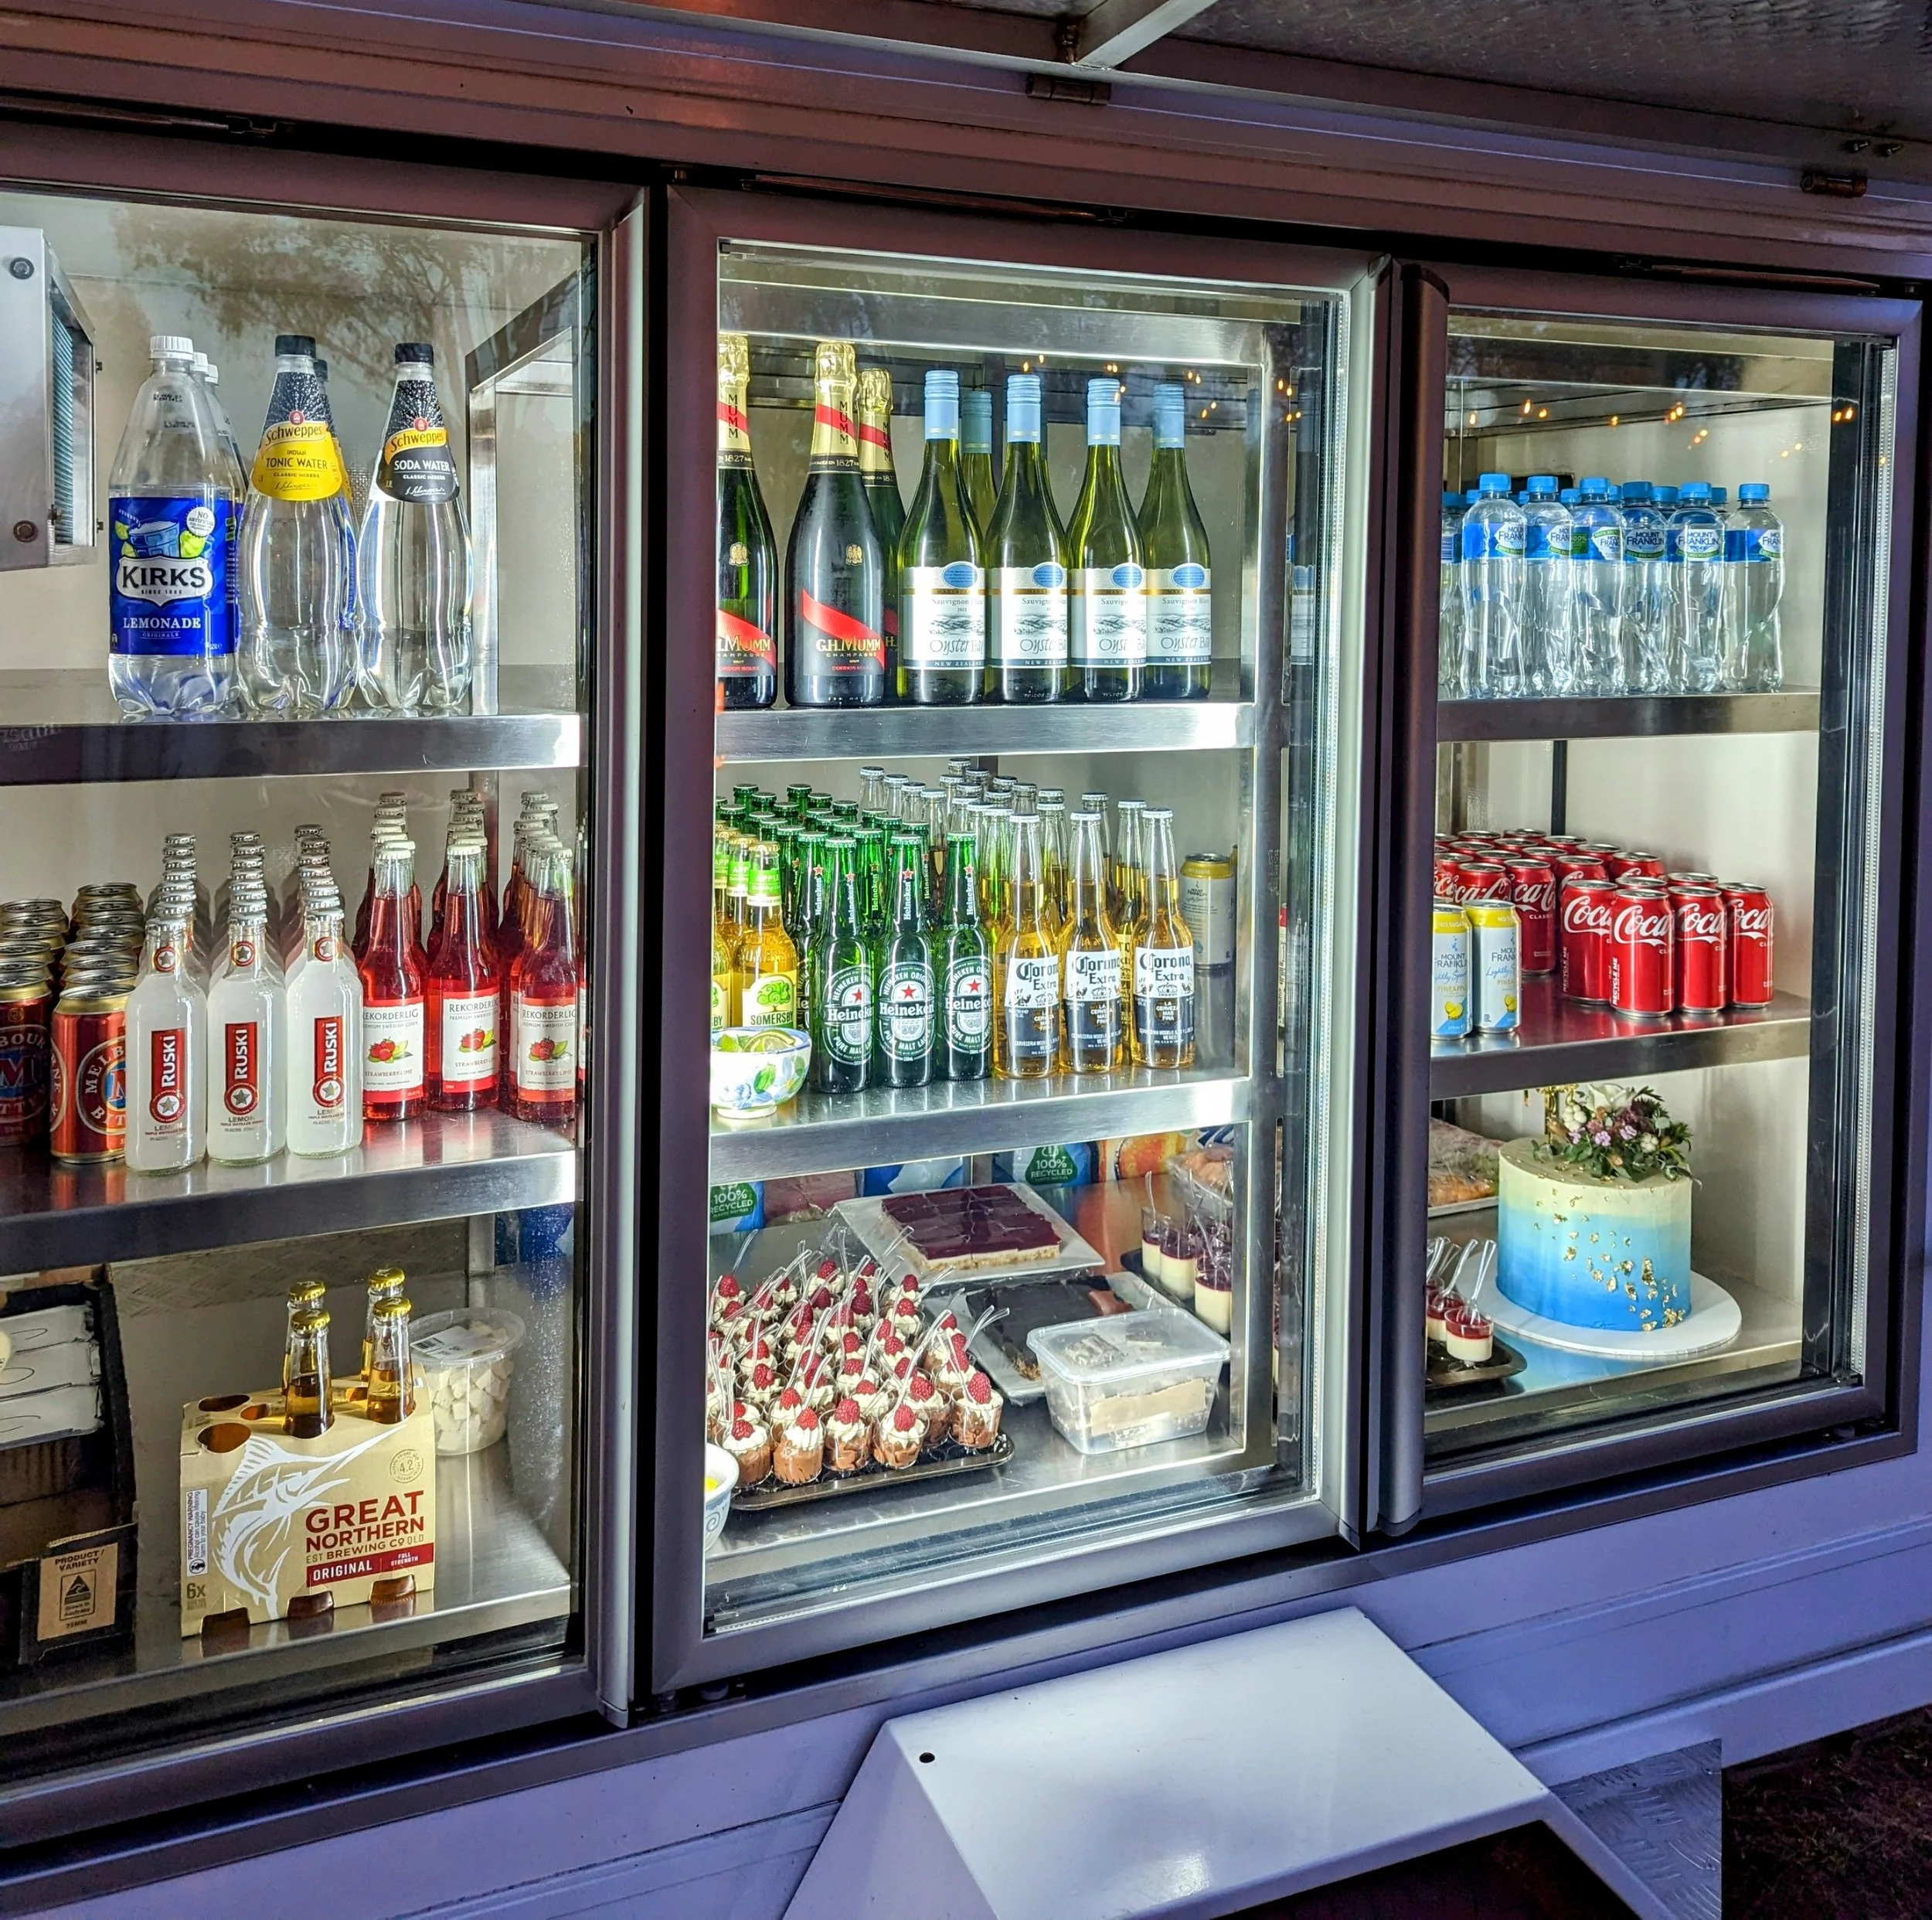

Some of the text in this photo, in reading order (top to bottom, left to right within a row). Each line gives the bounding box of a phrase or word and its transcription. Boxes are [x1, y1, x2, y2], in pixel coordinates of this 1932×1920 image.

[265, 426, 322, 446] Schweppes
[390, 432, 444, 452] Schweppes
[266, 458, 328, 469] TONIC WATER
[394, 460, 451, 471] SODA WATER
[1498, 532, 1524, 540] FRANK
[1550, 533, 1570, 541] FRAN
[1627, 537, 1665, 546] FRANKLIN
[1679, 536, 1719, 545] FRANKLIN
[1763, 536, 1781, 545] FRAN
[122, 566, 206, 588] KIRKS
[1162, 597, 1198, 606] Sauvignon
[123, 618, 201, 629] LEMONADE
[718, 635, 770, 651] .MUMM
[930, 638, 969, 655] Oyster
[1020, 638, 1053, 655] Oyst
[1099, 638, 1127, 654] Oyst
[1161, 637, 1198, 652] Oyster
[903, 880, 912, 921] Heineken
[1139, 952, 1192, 972] Corona
[1613, 957, 1618, 972] ME
[1016, 962, 1059, 982] Coron
[1089, 972, 1116, 984] Extra
[1155, 970, 1184, 981] Extra
[1486, 967, 1509, 979] Lightly
[832, 975, 859, 1000] HEINEKEN
[1033, 979, 1057, 991] Extra
[879, 1002, 934, 1016] Heineken
[945, 997, 992, 1011] Heineke
[750, 1011, 794, 1026] SOMERSBY
[827, 1006, 872, 1021] Heineke
[951, 1024, 981, 1043] PURE MALT
[324, 1022, 338, 1074] RUSKI
[833, 1036, 847, 1051] PURE
[899, 1041, 916, 1050] MALT
[161, 1035, 176, 1088] RUSKI
[234, 1029, 248, 1080] RUSKI
[365, 1069, 413, 1077] STRAWBERRY-LIME
[1036, 1159, 1067, 1169] 100%
[1031, 1168, 1073, 1180] RECYCLED
[713, 1189, 747, 1205] 100%
[711, 1199, 753, 1214] RECYCLED
[399, 1459, 414, 1473] 4.2
[305, 1489, 424, 1534] GREAT
[306, 1517, 424, 1553] NORTHERN
[306, 1553, 324, 1564] EST
[327, 1541, 386, 1560] BREWING
[407, 1534, 424, 1545] QLD
[55, 1550, 99, 1565] PRODUCT
[60, 1557, 99, 1571] VARIETY
[391, 1556, 418, 1567] STRENGTH
[313, 1560, 372, 1581] ORIGINAL
[186, 1583, 206, 1599] 6x
